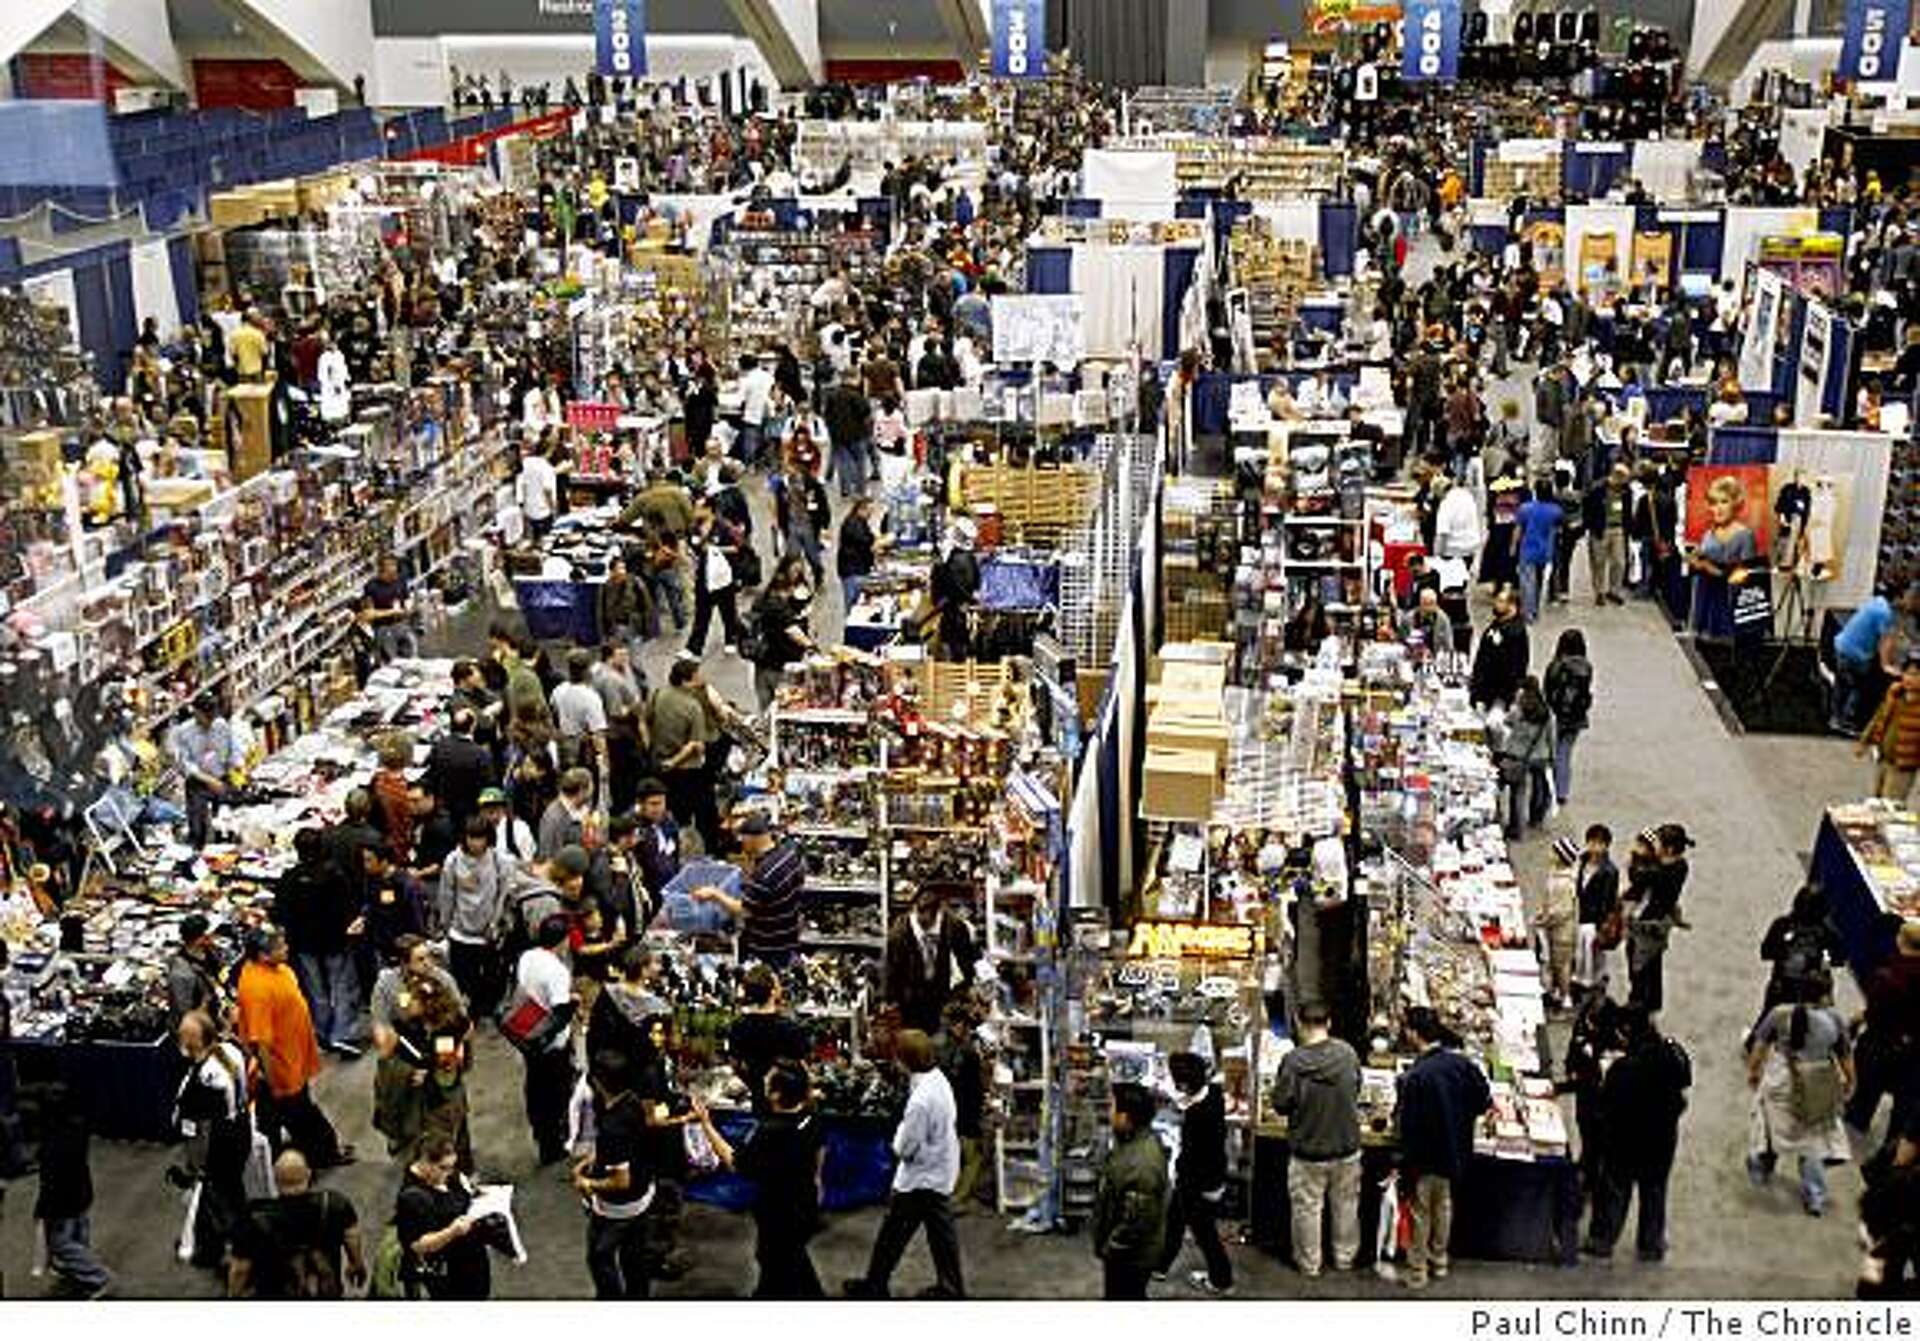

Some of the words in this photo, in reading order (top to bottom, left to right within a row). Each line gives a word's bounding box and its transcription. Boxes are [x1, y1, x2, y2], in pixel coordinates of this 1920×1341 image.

[611, 8, 631, 71] 200
[1419, 10, 1442, 74] 400
[1858, 8, 1886, 77] 500
